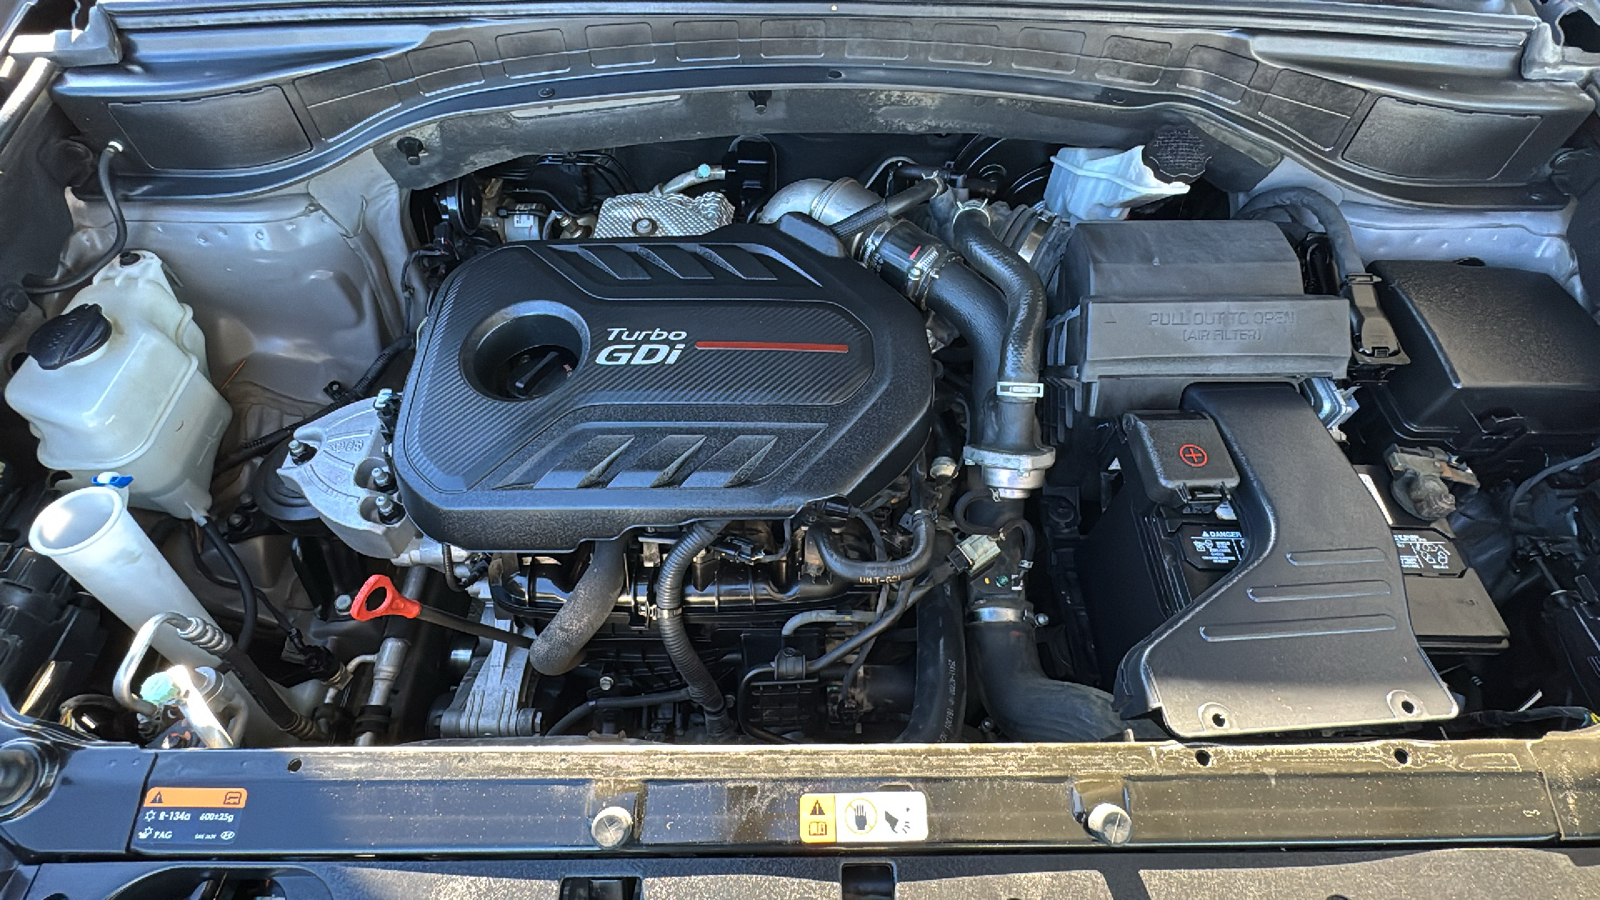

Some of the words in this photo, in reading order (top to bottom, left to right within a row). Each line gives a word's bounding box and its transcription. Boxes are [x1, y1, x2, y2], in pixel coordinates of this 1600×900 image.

[1149, 312, 1190, 326] PULL
[1193, 312, 1226, 326] OUT
[1227, 311, 1250, 325] TO
[1254, 311, 1295, 325] OPEN
[606, 327, 688, 341] Turbo
[1183, 329, 1210, 341] (AIR
[1213, 329, 1262, 341] FILTER)
[594, 343, 686, 366] GDi
[158, 811, 192, 821] R-134a
[199, 811, 235, 822] 600±25g
[153, 830, 173, 839] PAG
